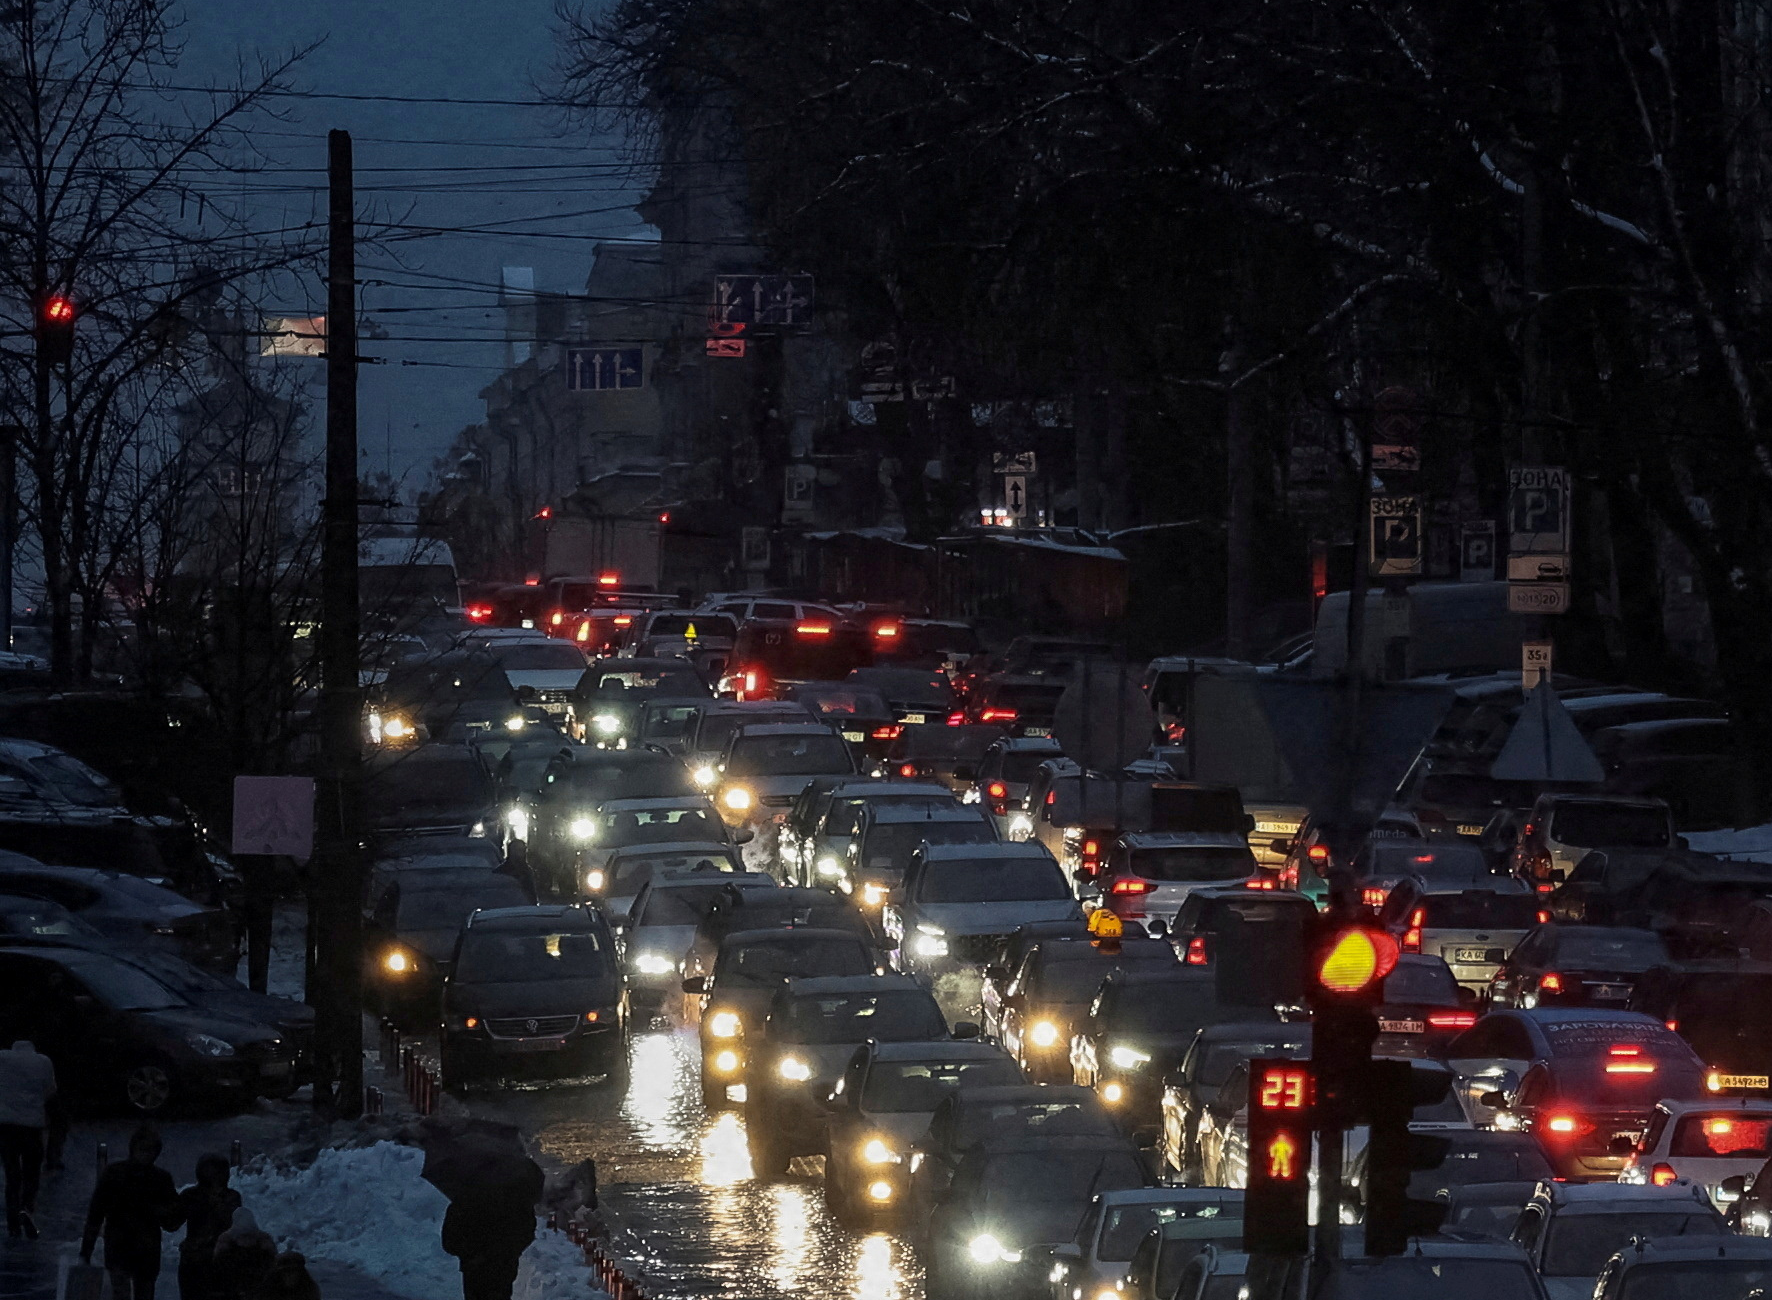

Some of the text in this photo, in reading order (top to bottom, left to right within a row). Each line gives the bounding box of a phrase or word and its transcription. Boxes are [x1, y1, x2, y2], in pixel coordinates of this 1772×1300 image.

[1511, 472, 1562, 488] ЗОНА
[1543, 594, 1556, 605] 20
[1262, 1075, 1303, 1107] 23
